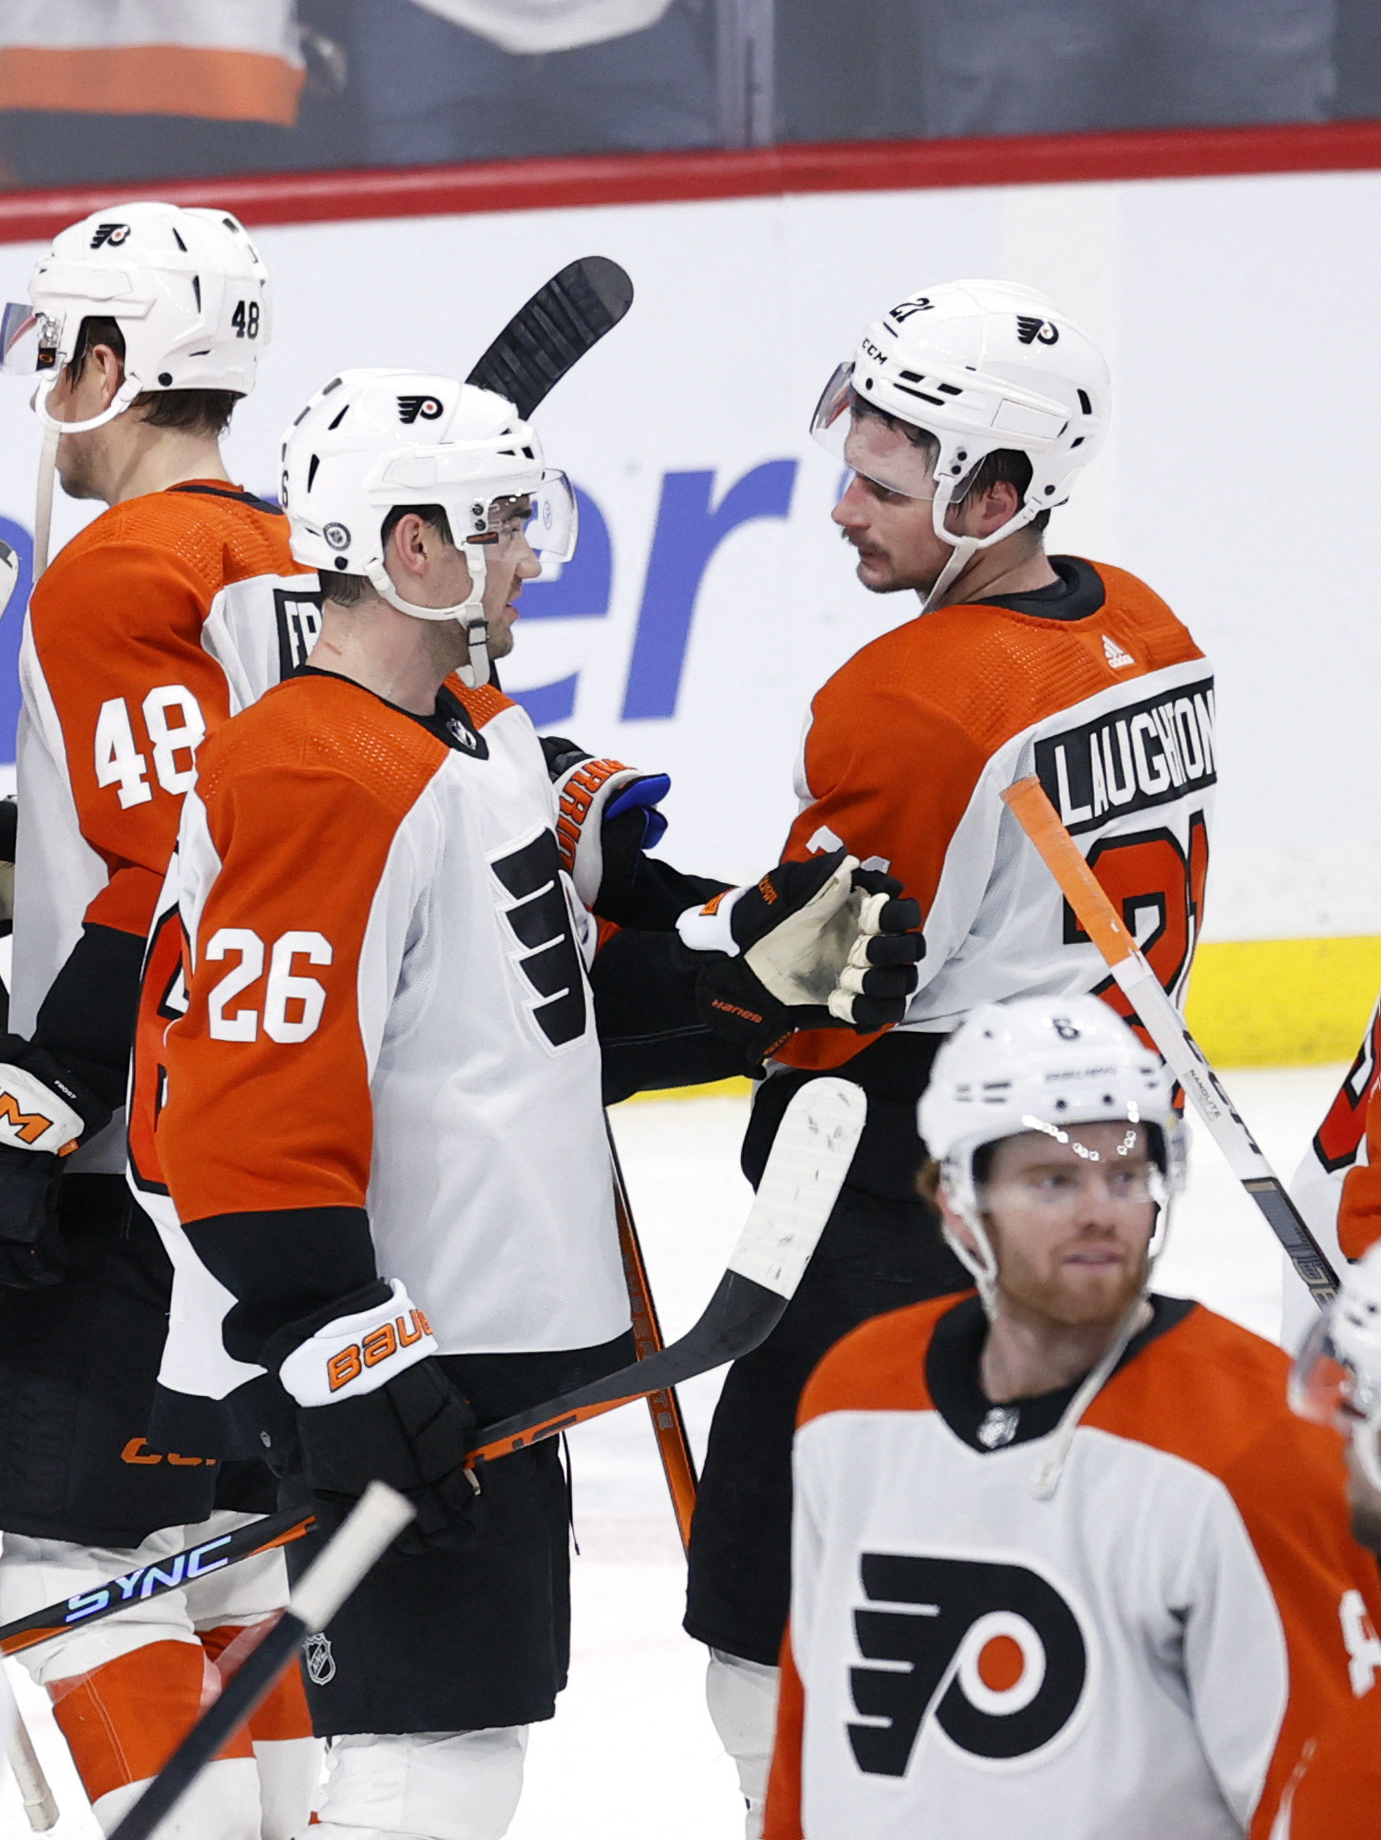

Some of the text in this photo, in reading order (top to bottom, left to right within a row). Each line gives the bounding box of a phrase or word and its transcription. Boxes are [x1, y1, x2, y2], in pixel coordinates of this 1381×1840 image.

[231, 299, 259, 339] 48
[862, 338, 888, 365] CCM
[888, 297, 935, 323] 21
[94, 684, 207, 810] 48
[1054, 689, 1215, 827] LAUGHTON
[205, 928, 333, 1043] 26
[64, 1535, 233, 1623] SYNC
